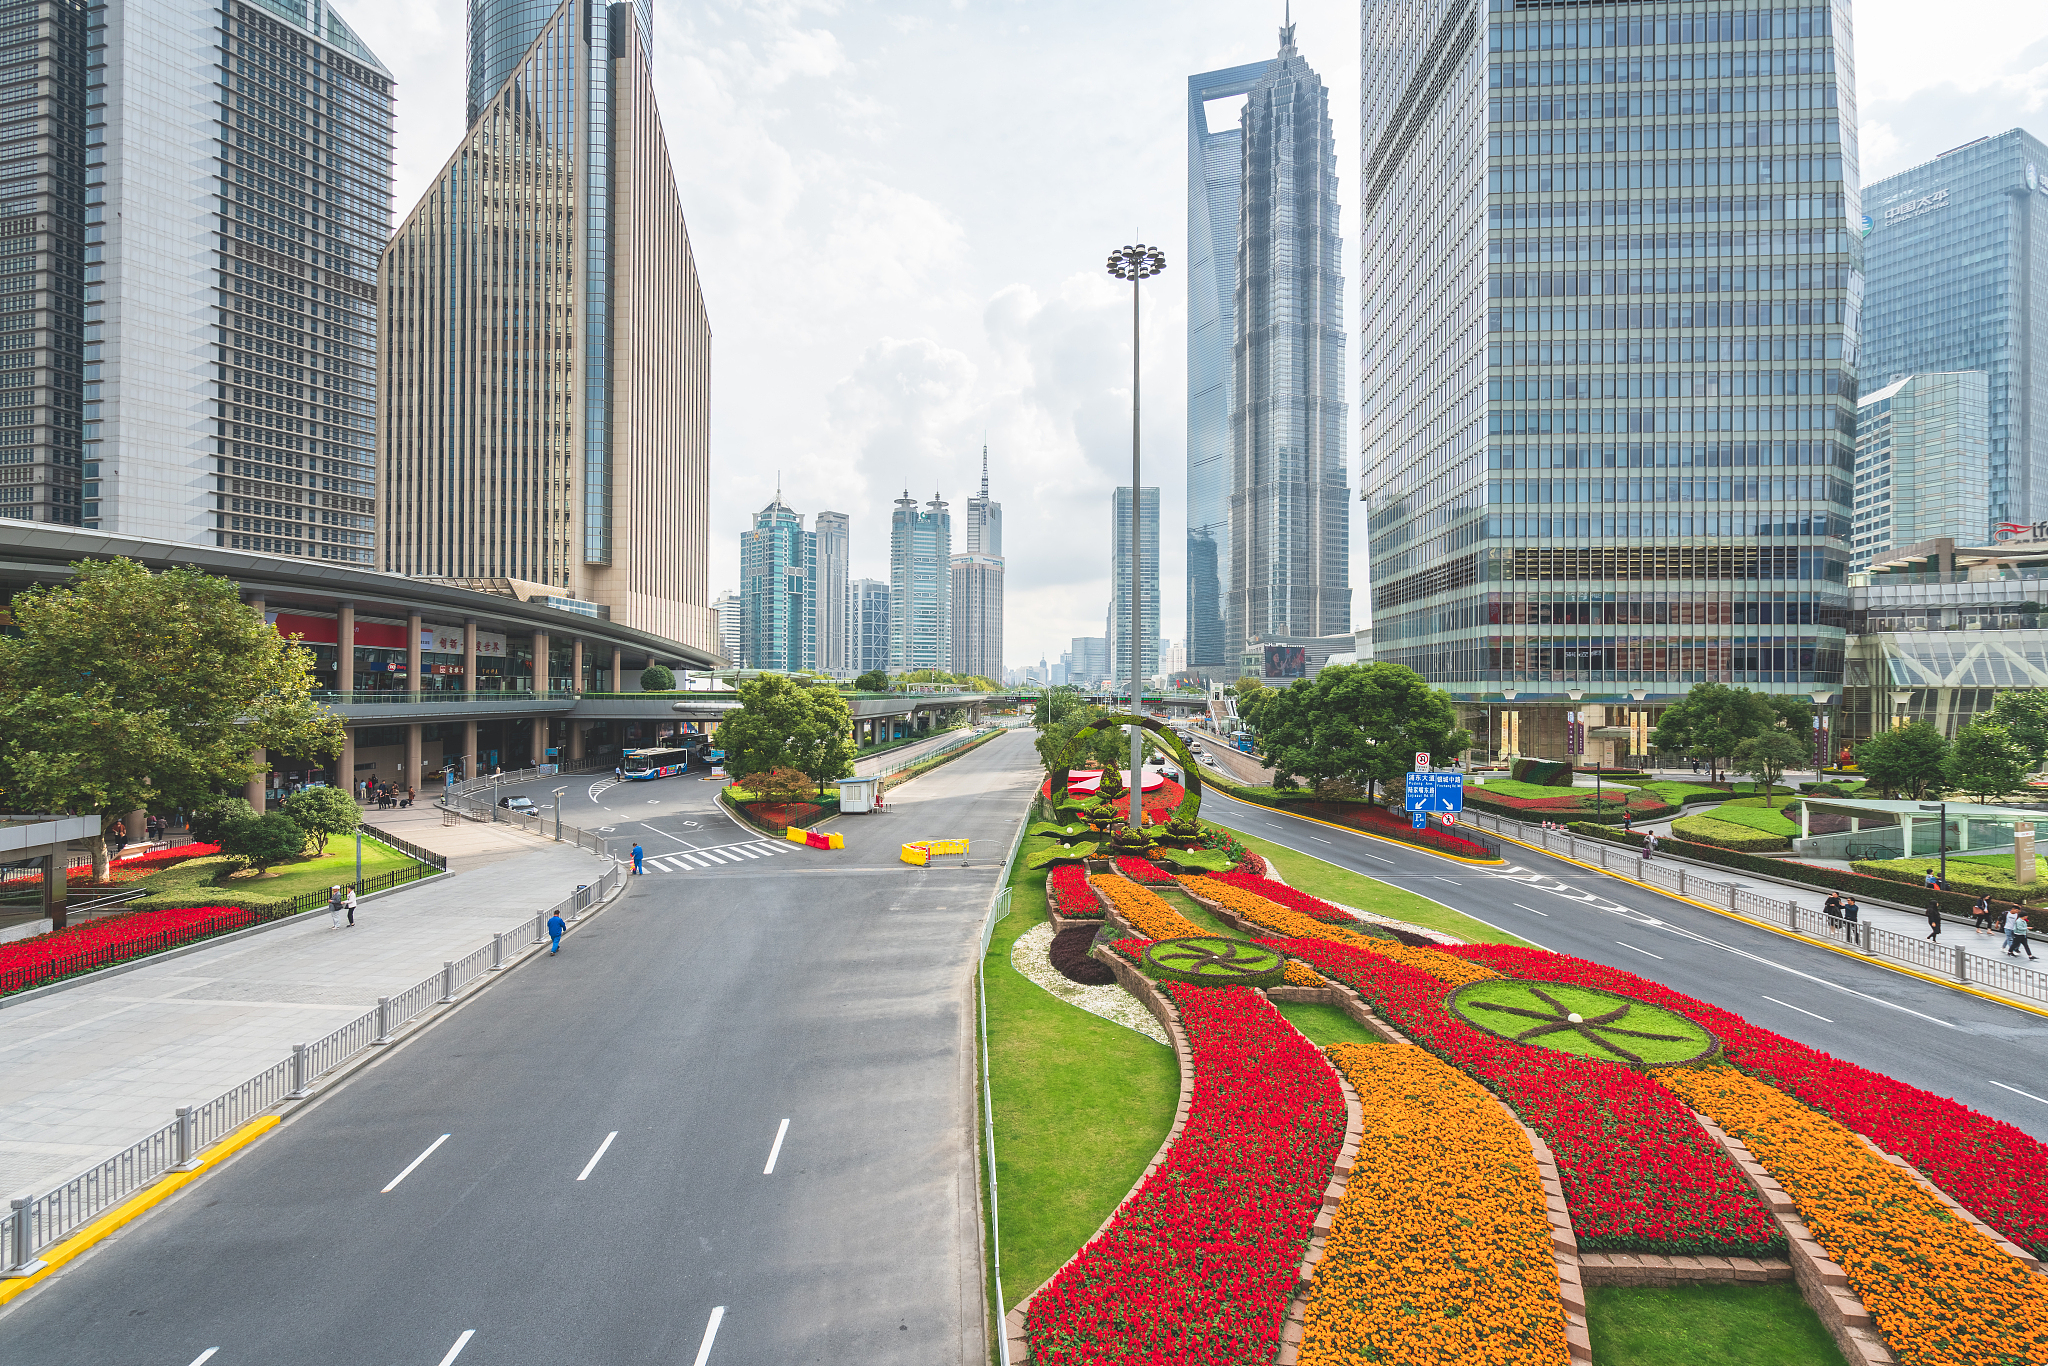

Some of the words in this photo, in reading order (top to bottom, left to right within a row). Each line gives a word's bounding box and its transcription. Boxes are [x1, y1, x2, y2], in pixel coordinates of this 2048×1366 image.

[1884, 188, 1950, 219] 中国太平
[1884, 213, 1911, 227] CHINA
[1914, 200, 1950, 217] TAIPING
[1408, 774, 1435, 782] 浦东大道
[1414, 813, 1422, 822] P
